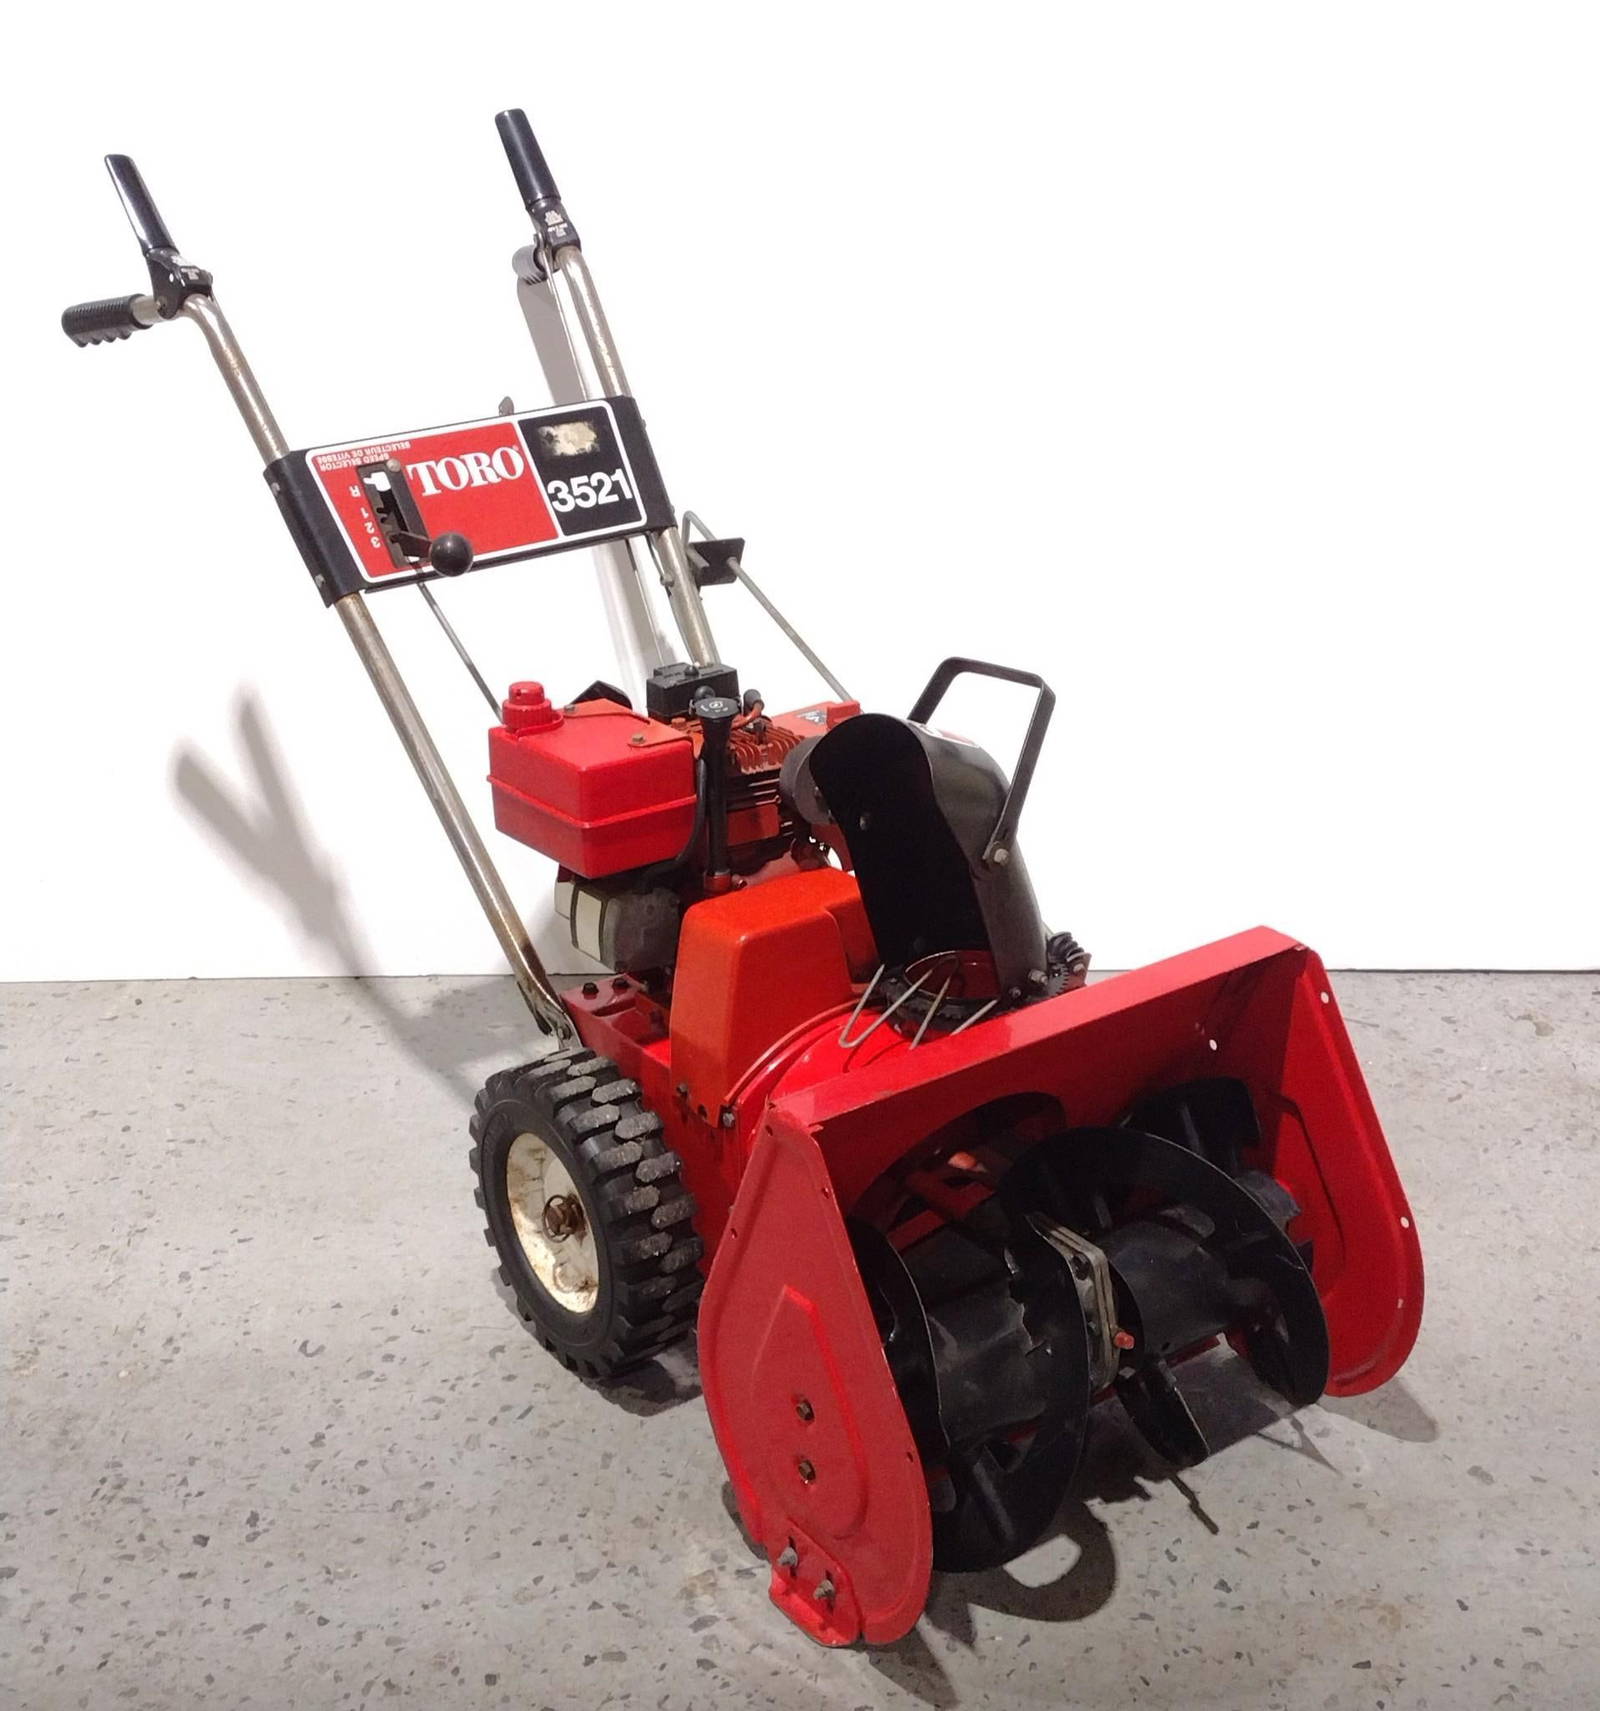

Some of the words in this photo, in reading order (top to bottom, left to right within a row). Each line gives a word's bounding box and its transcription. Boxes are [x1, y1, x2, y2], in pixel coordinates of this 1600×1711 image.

[352, 449, 364, 457] DE
[363, 453, 390, 465] SPEED
[320, 458, 362, 471] SELECTOR
[406, 450, 524, 497] TORO
[349, 485, 360, 497] R
[547, 468, 633, 513] 3521
[361, 507, 369, 518] 1
[365, 522, 375, 534] 2
[370, 536, 381, 548] 3
